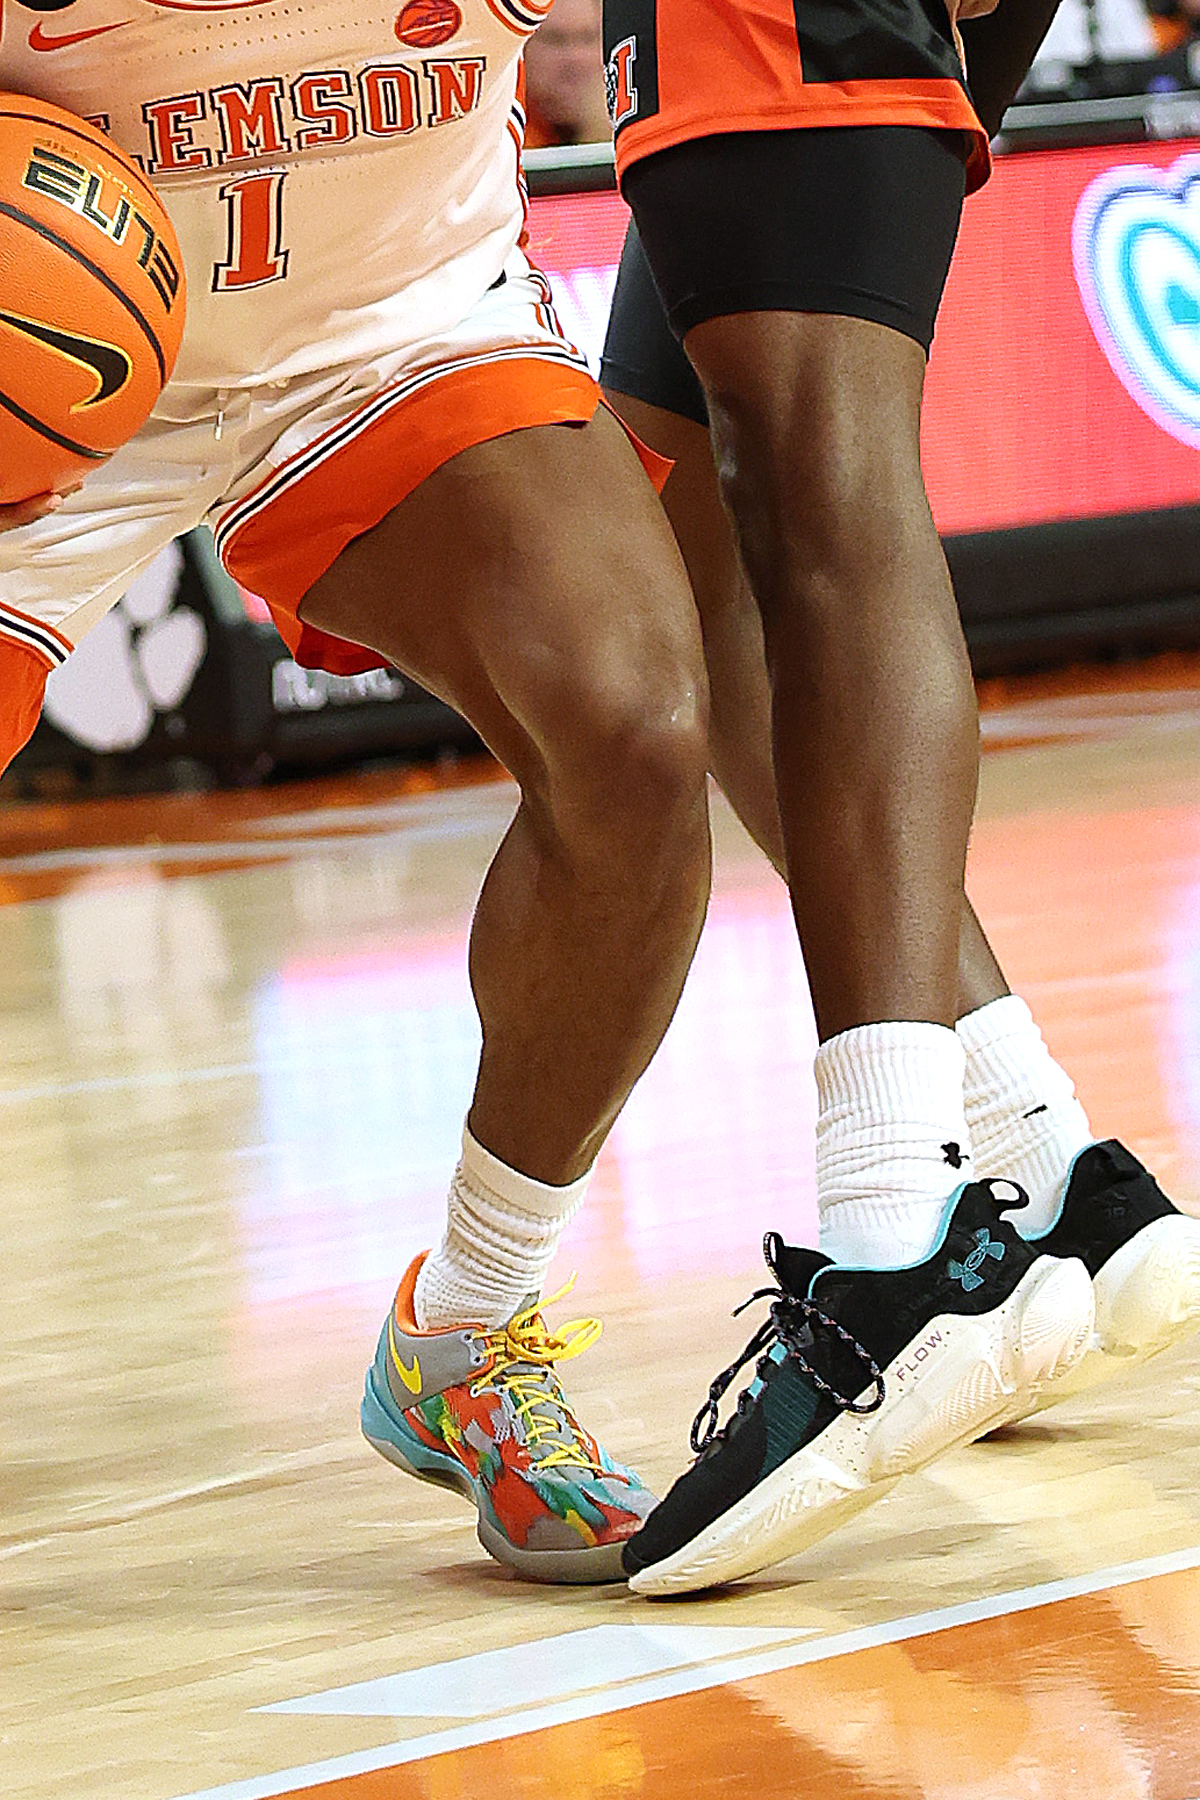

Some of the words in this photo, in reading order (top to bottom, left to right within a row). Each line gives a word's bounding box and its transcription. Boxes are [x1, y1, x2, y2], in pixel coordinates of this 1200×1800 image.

[21, 145, 182, 315] ELITE
[211, 171, 290, 294] 1
[895, 1330, 943, 1382] FLOW
